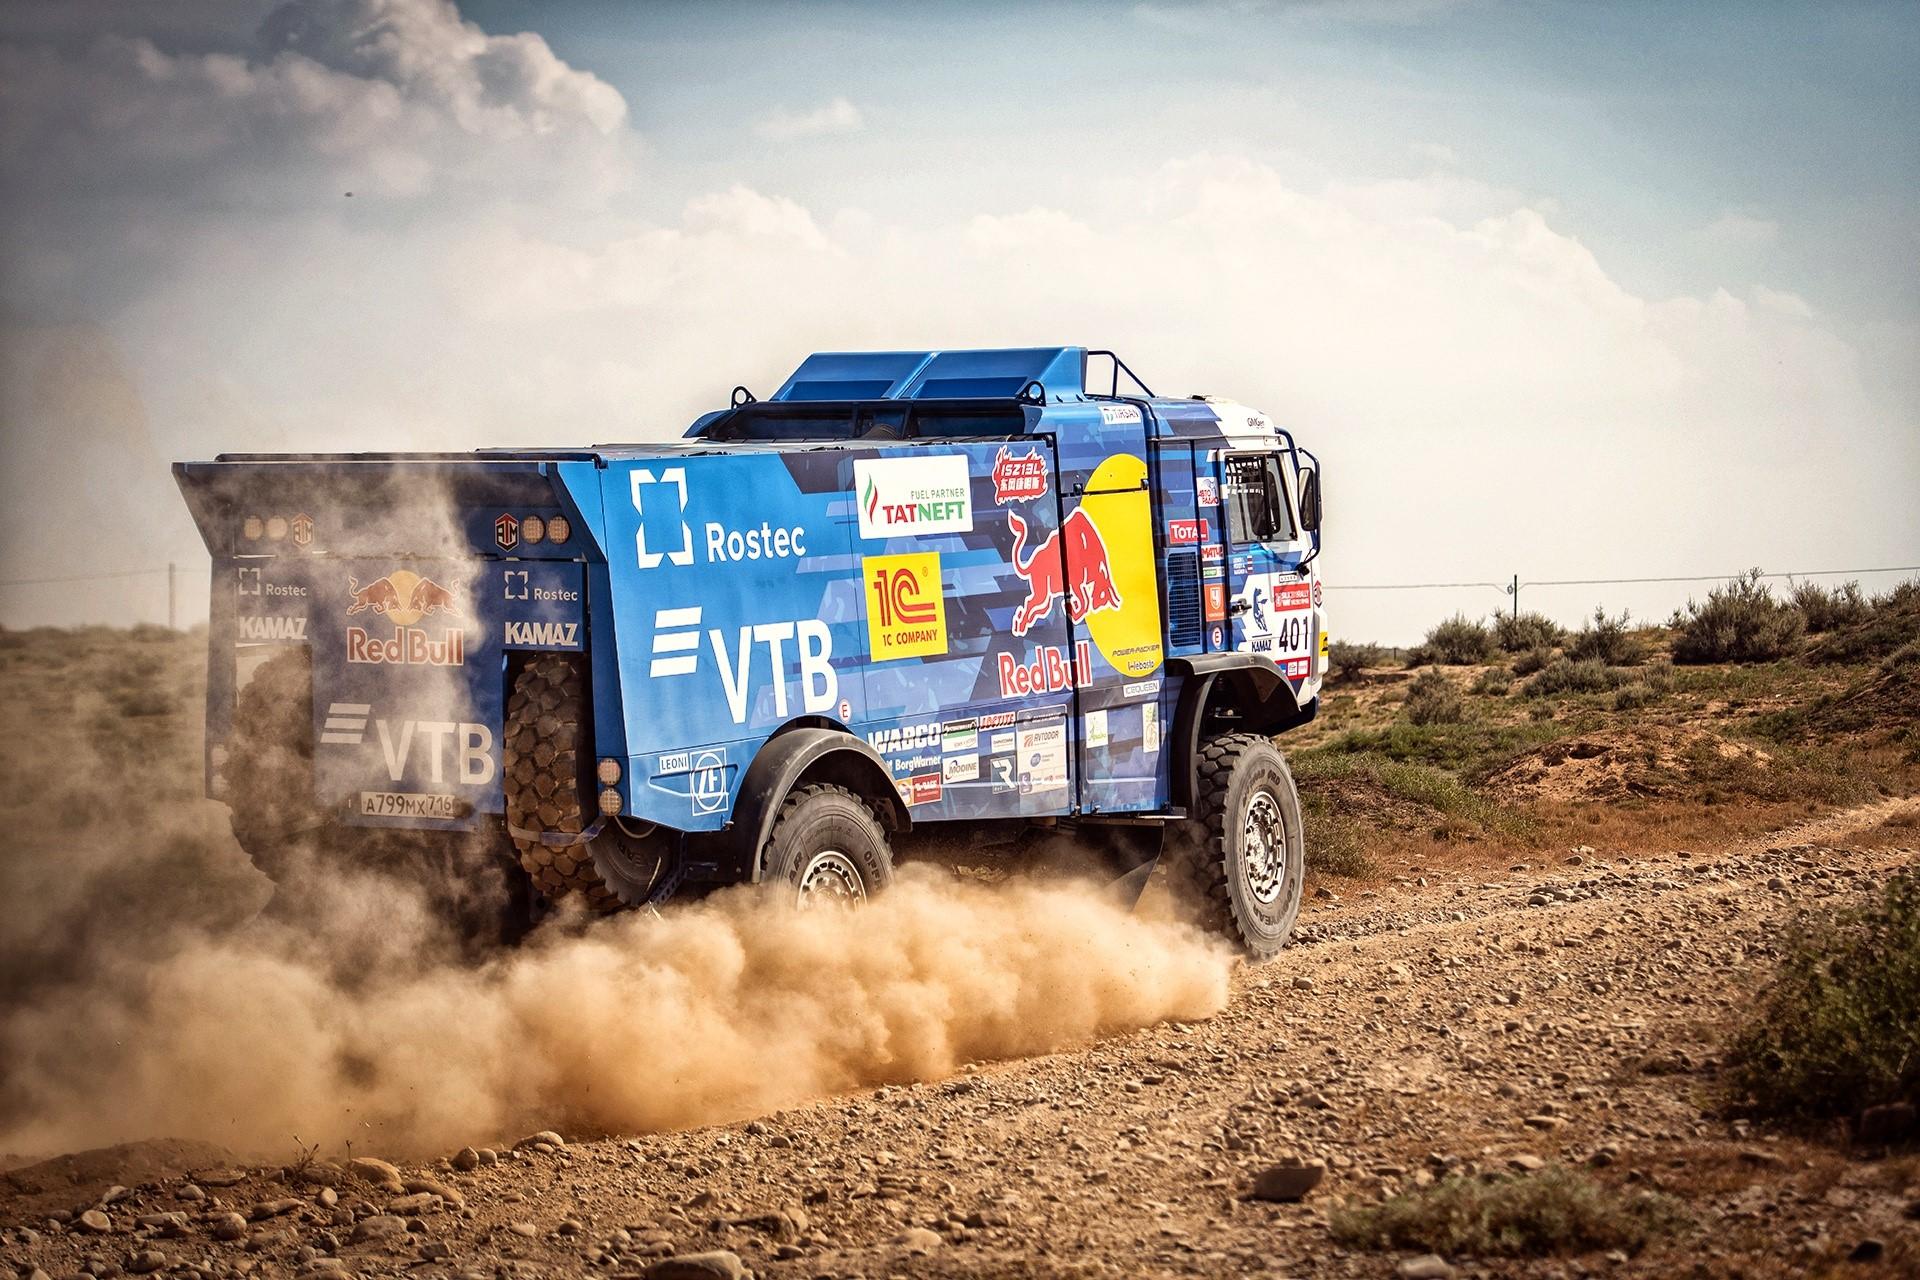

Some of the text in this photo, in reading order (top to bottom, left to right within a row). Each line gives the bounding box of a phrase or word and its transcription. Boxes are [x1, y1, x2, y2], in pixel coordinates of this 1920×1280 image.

[910, 488, 965, 500] FUEL PARTNER
[882, 501, 965, 524] TATNEFT
[705, 521, 807, 563] Rostec
[266, 583, 307, 596] Rostec
[534, 587, 578, 601] Rostec
[240, 616, 308, 640] KAMAZ
[505, 622, 578, 646] KAMAZ
[883, 629, 938, 647] 1C COMPANY
[1279, 616, 1308, 652] 401
[347, 626, 464, 666] Red Bull
[1251, 640, 1272, 652] KAMAZ
[708, 619, 839, 725] VTB
[998, 640, 1093, 699] Red Bull
[868, 722, 942, 754] WABCO
[376, 719, 495, 785] VTB
[661, 756, 688, 770] LEONI
[895, 755, 941, 772] BorgWarner
[949, 762, 977, 775] MODINE
[428, 796, 452, 811] 716
